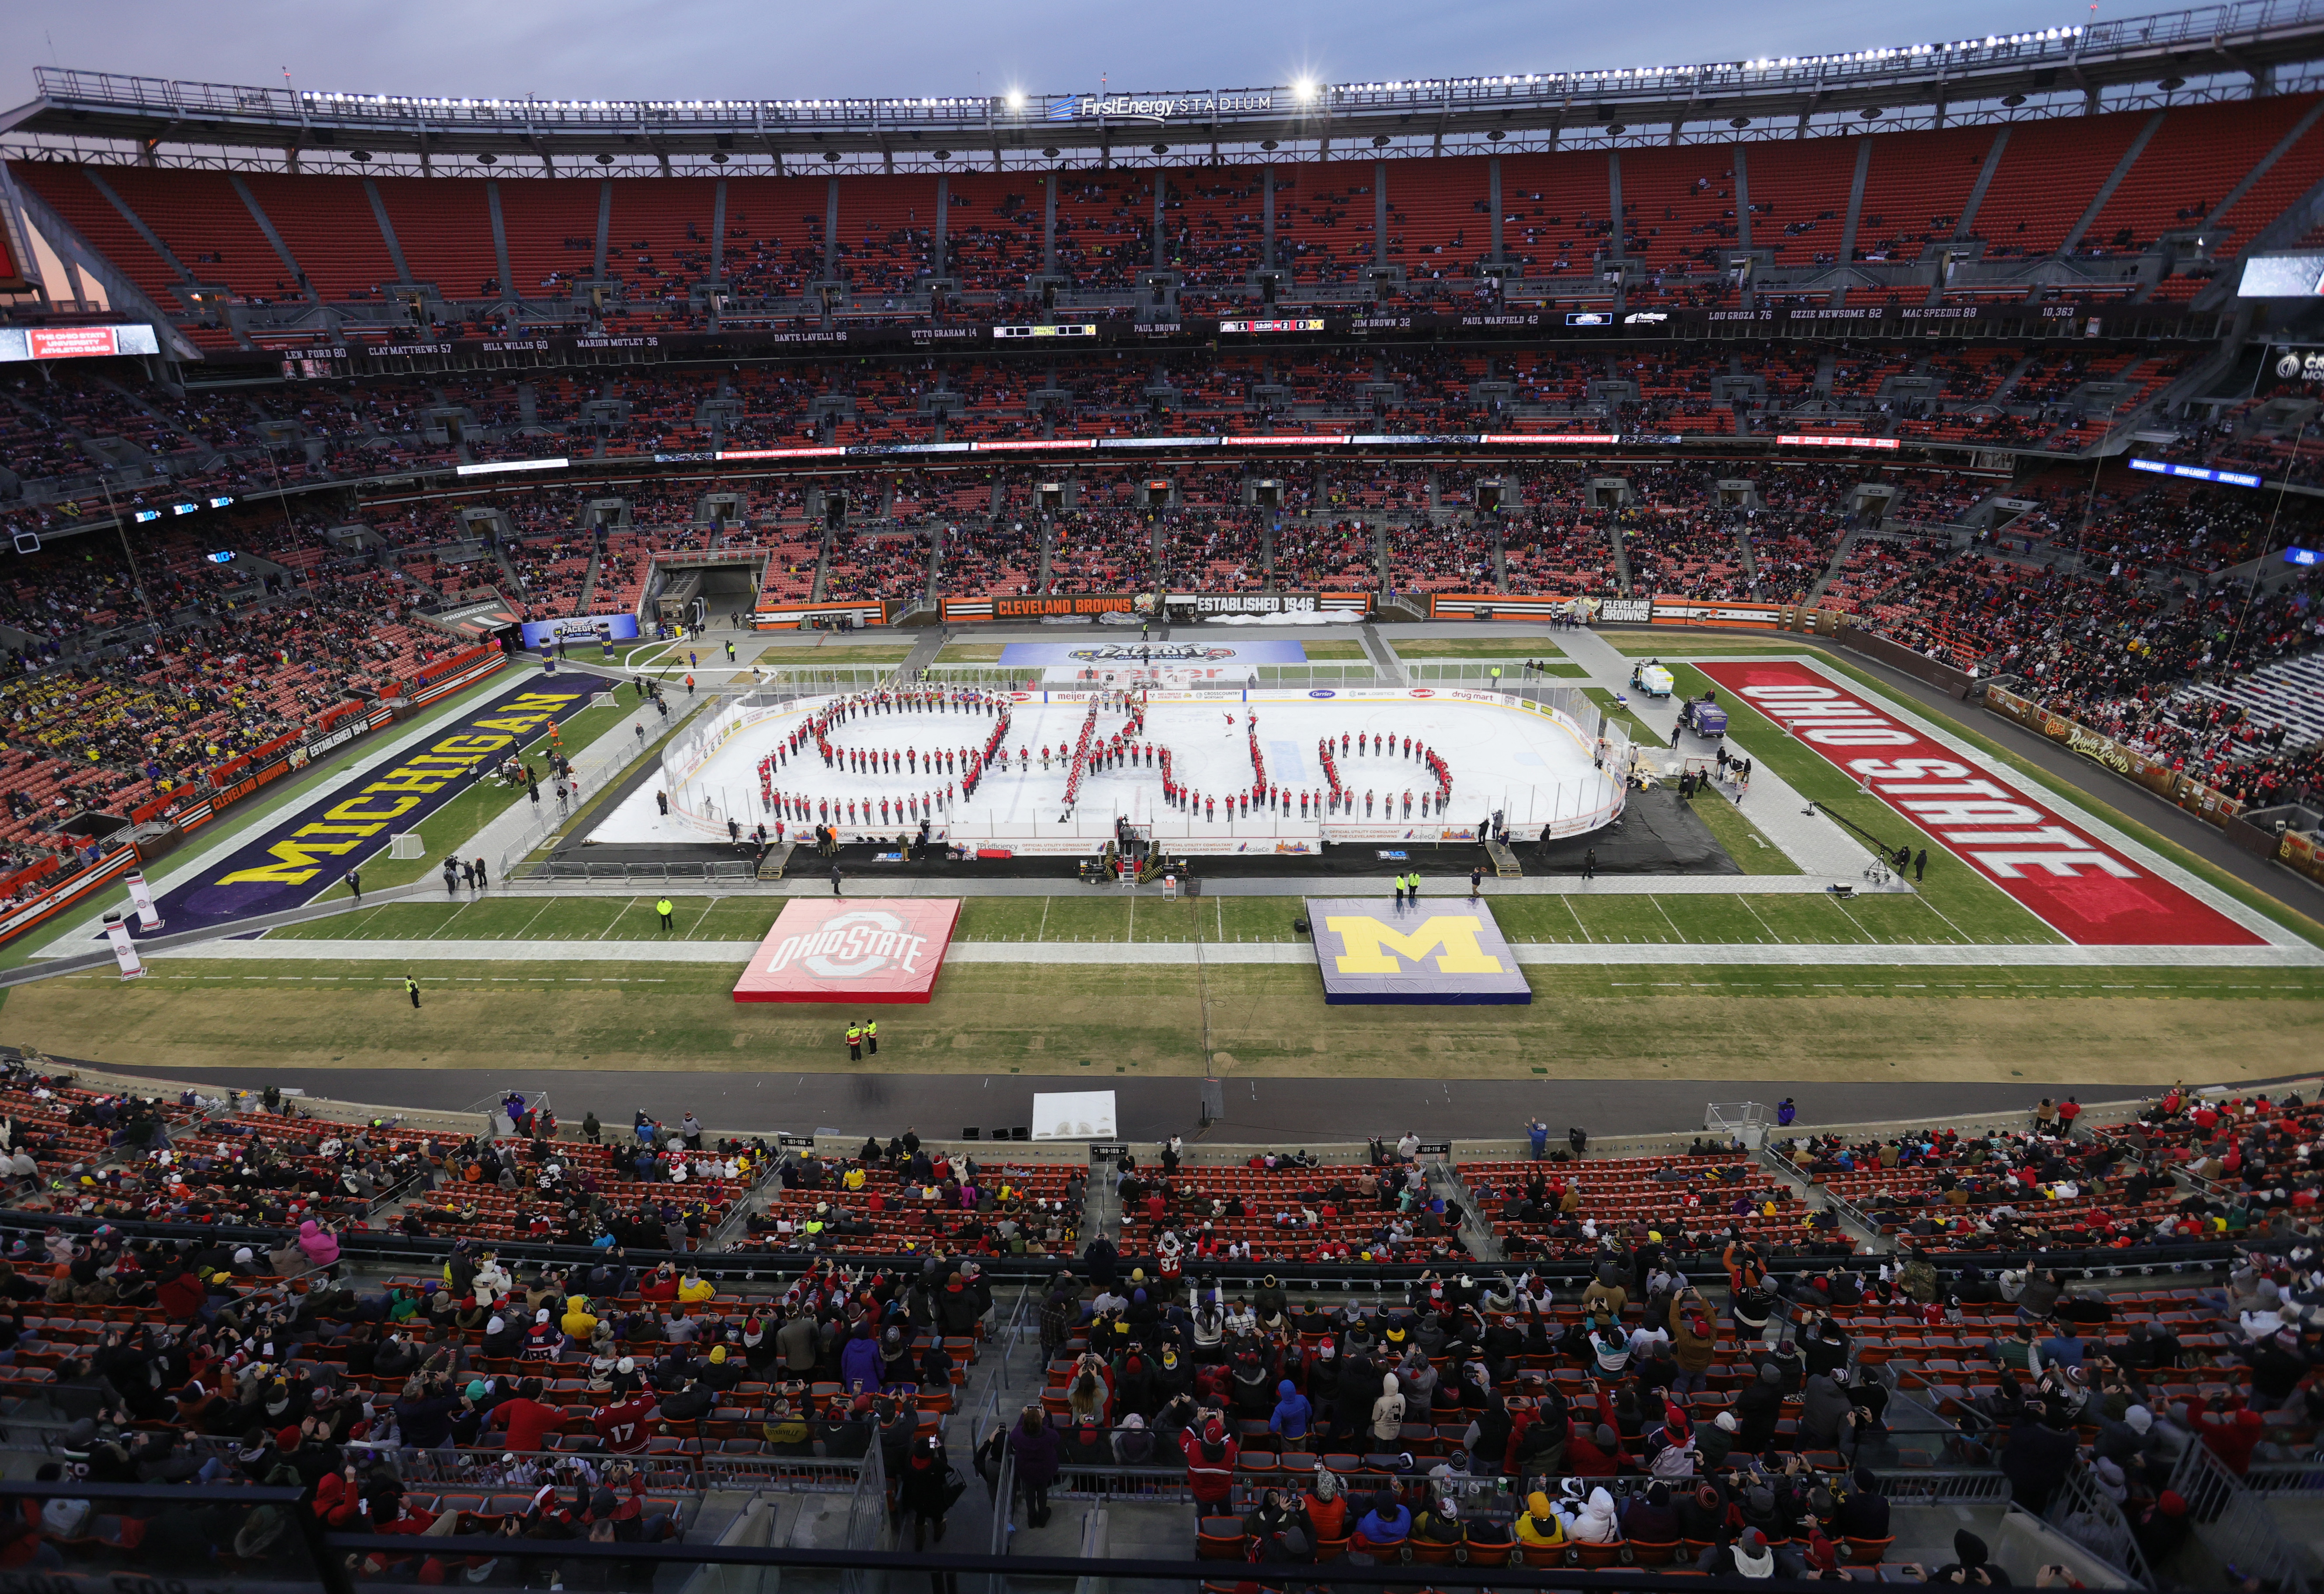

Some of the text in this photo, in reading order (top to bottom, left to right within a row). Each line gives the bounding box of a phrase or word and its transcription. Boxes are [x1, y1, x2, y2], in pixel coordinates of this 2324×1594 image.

[1082, 96, 1271, 116] FirstEnergy STADIUM
[1709, 311, 1772, 320] LOU GROZA 76
[1790, 308, 1882, 319] OZZIE NEWSOME 82
[1902, 308, 1977, 318] MAC SPEEDIE 88
[2043, 307, 2074, 317] 10,363
[1369, 319, 1396, 327] BROWN
[1400, 318, 1410, 326] 32
[1484, 316, 1524, 324] WARFIELD
[1527, 315, 1538, 324] 42
[934, 329, 966, 337] GRAHAM
[969, 328, 977, 337] 14
[1155, 323, 1180, 332] BROWN
[576, 337, 658, 347] MARION MOTLEY 36
[774, 332, 846, 342] DANTE LAVELLI 86
[368, 344, 451, 356] CLAY MATTHEWS 57
[482, 341, 548, 351] BILL WILLIS 60
[285, 348, 347, 360] LEN FORD 80
[2133, 460, 2165, 472] BUD LIGHT
[2175, 466, 2210, 478] BUD LIGHT
[2233, 475, 2255, 485] LIGHT
[2295, 555, 2316, 565] LIGHT
[999, 599, 1131, 614] CLEVELAND BROWNS
[1197, 597, 1315, 611] ESTABLISHED 1946
[1603, 600, 1650, 610] CLEVELAND
[442, 603, 499, 622] PROGRESSIVE
[1602, 610, 1649, 621] BROWNS
[489, 622, 513, 634] PROGRESSIVE
[562, 625, 597, 634] FACEOFF
[1058, 691, 1086, 701] meijer
[1452, 691, 1471, 700] drug
[309, 720, 368, 758] ESTABLISHED 1946
[2065, 726, 2128, 773] DAWG POUND
[687, 758, 700, 775] meijer
[212, 760, 289, 811] CLEVELAND BROWNS
[1738, 685, 2143, 878] OHIO STATE
[214, 693, 583, 886] MICHIGAN
[766, 925, 927, 974] OHIO STATE
[1325, 916, 1503, 973] M
[539, 1178, 552, 1188] 95
[258, 1212, 264, 1220] 9
[1160, 1256, 1179, 1272] 97
[528, 1348, 553, 1361] 88
[610, 1422, 635, 1443] 17
